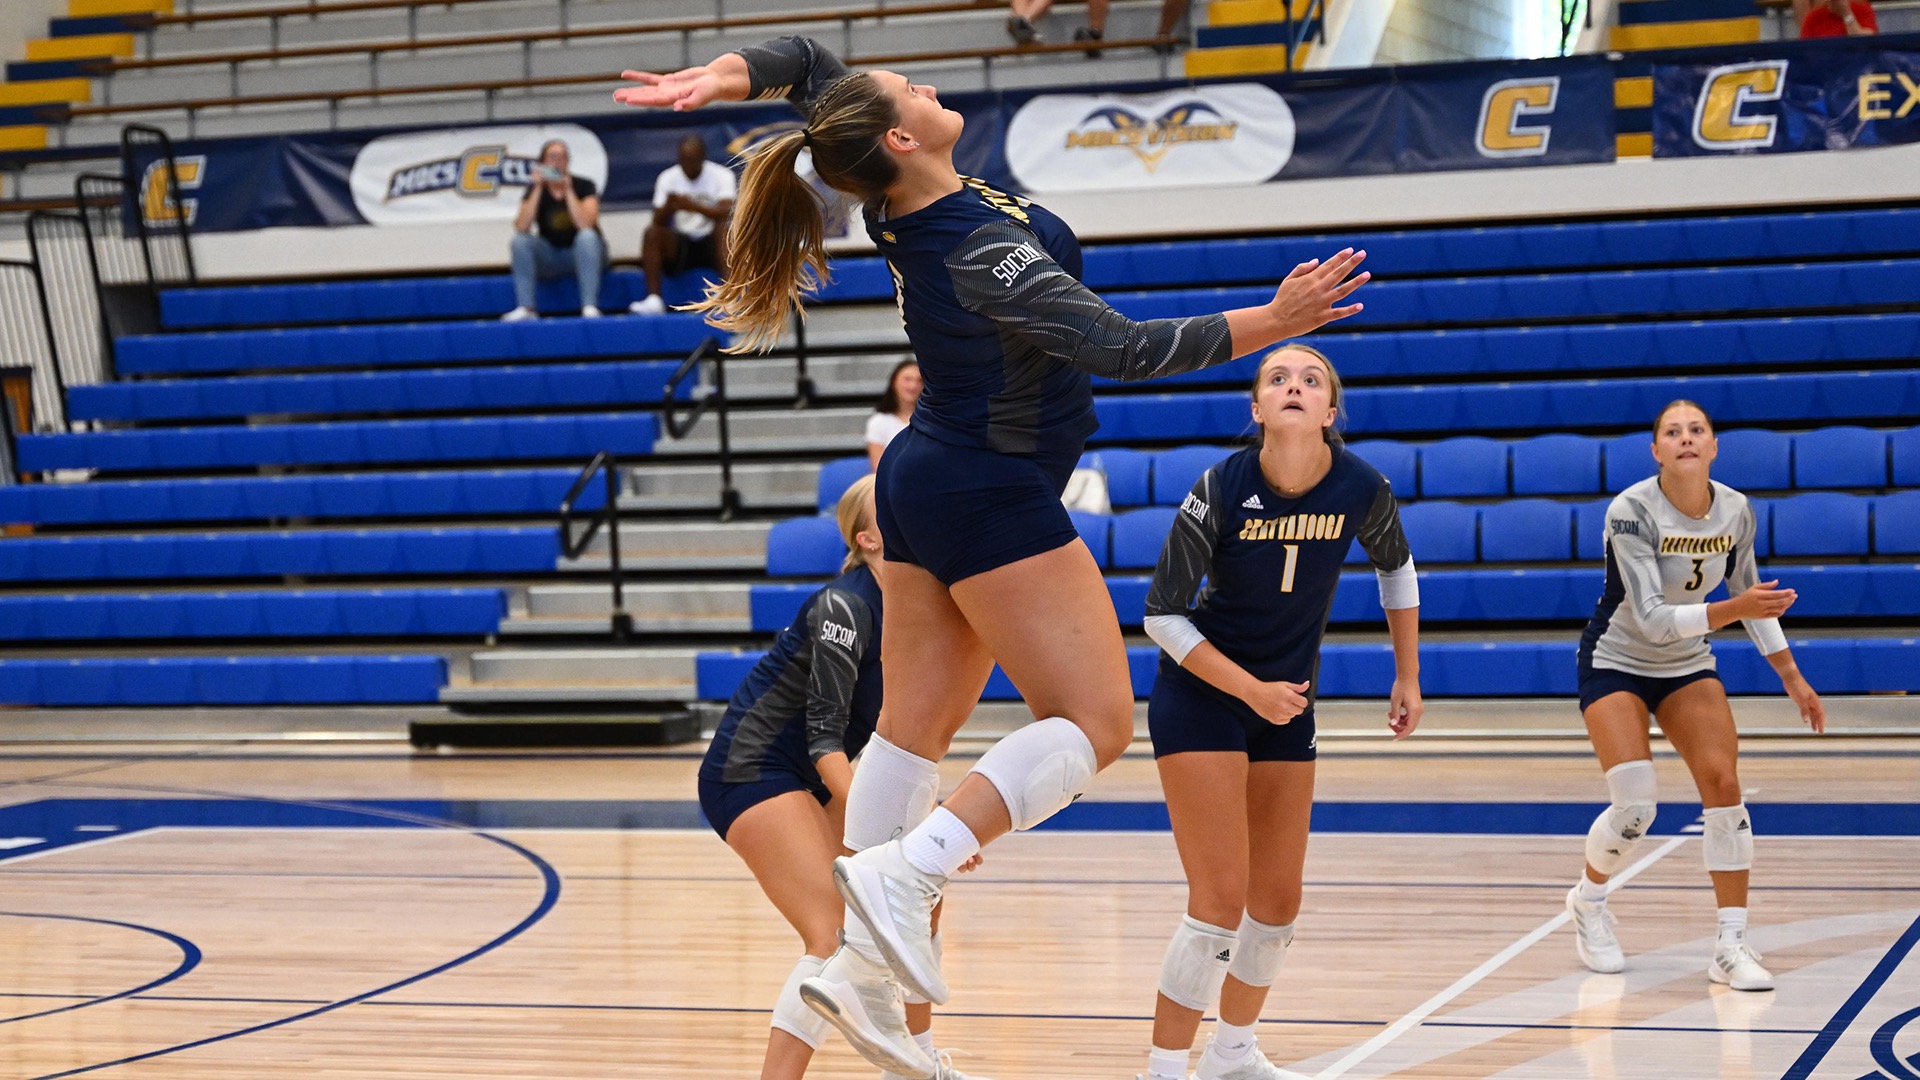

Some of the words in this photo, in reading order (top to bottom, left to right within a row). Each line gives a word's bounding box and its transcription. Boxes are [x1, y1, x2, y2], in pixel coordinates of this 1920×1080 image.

[1475, 76, 1561, 158] C
[1692, 60, 1788, 150] C
[139, 154, 208, 228] C
[992, 241, 1043, 287] SOCON
[1242, 502, 1264, 510] adidas
[1611, 519, 1640, 536] SOCON
[1281, 544, 1299, 593] 1
[1685, 558, 1704, 591] 3
[821, 620, 857, 651] SOCON
